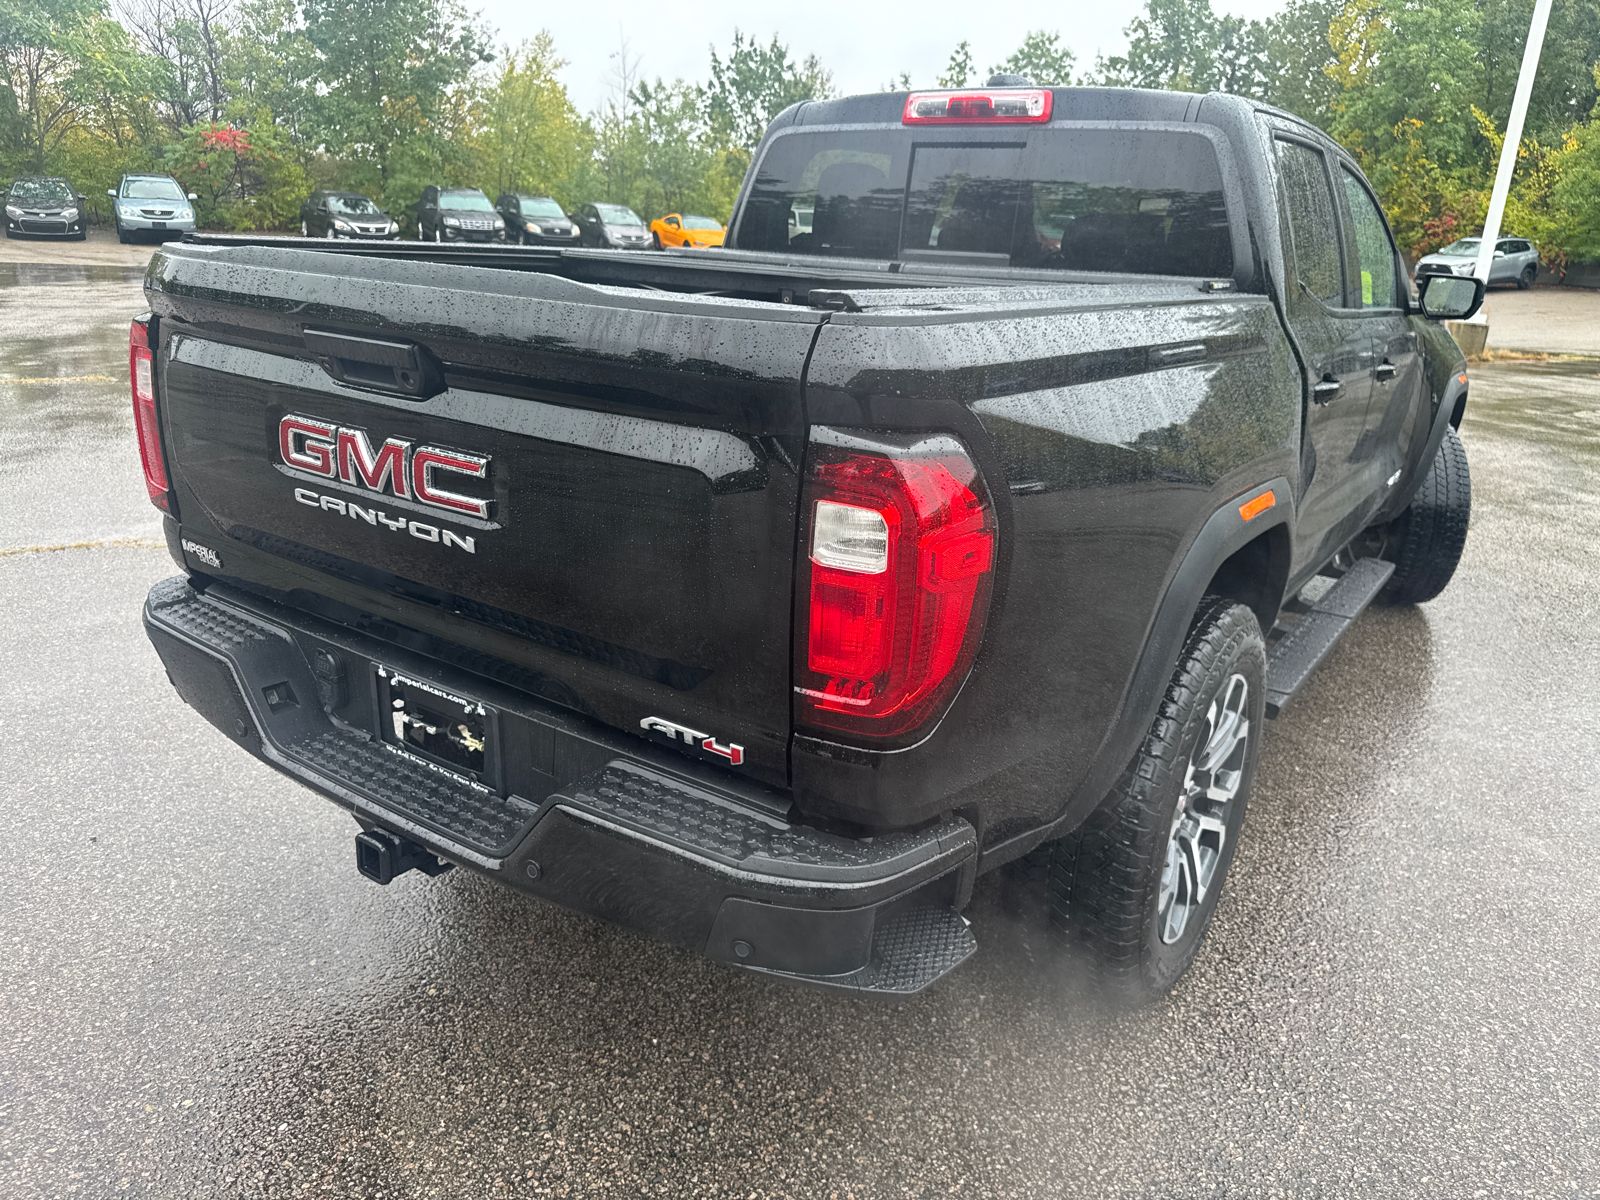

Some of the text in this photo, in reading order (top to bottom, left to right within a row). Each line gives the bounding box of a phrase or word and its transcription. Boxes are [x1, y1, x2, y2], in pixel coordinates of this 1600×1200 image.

[279, 413, 490, 520] GMC
[294, 488, 476, 554] CANYON
[640, 716, 744, 765] AT4
